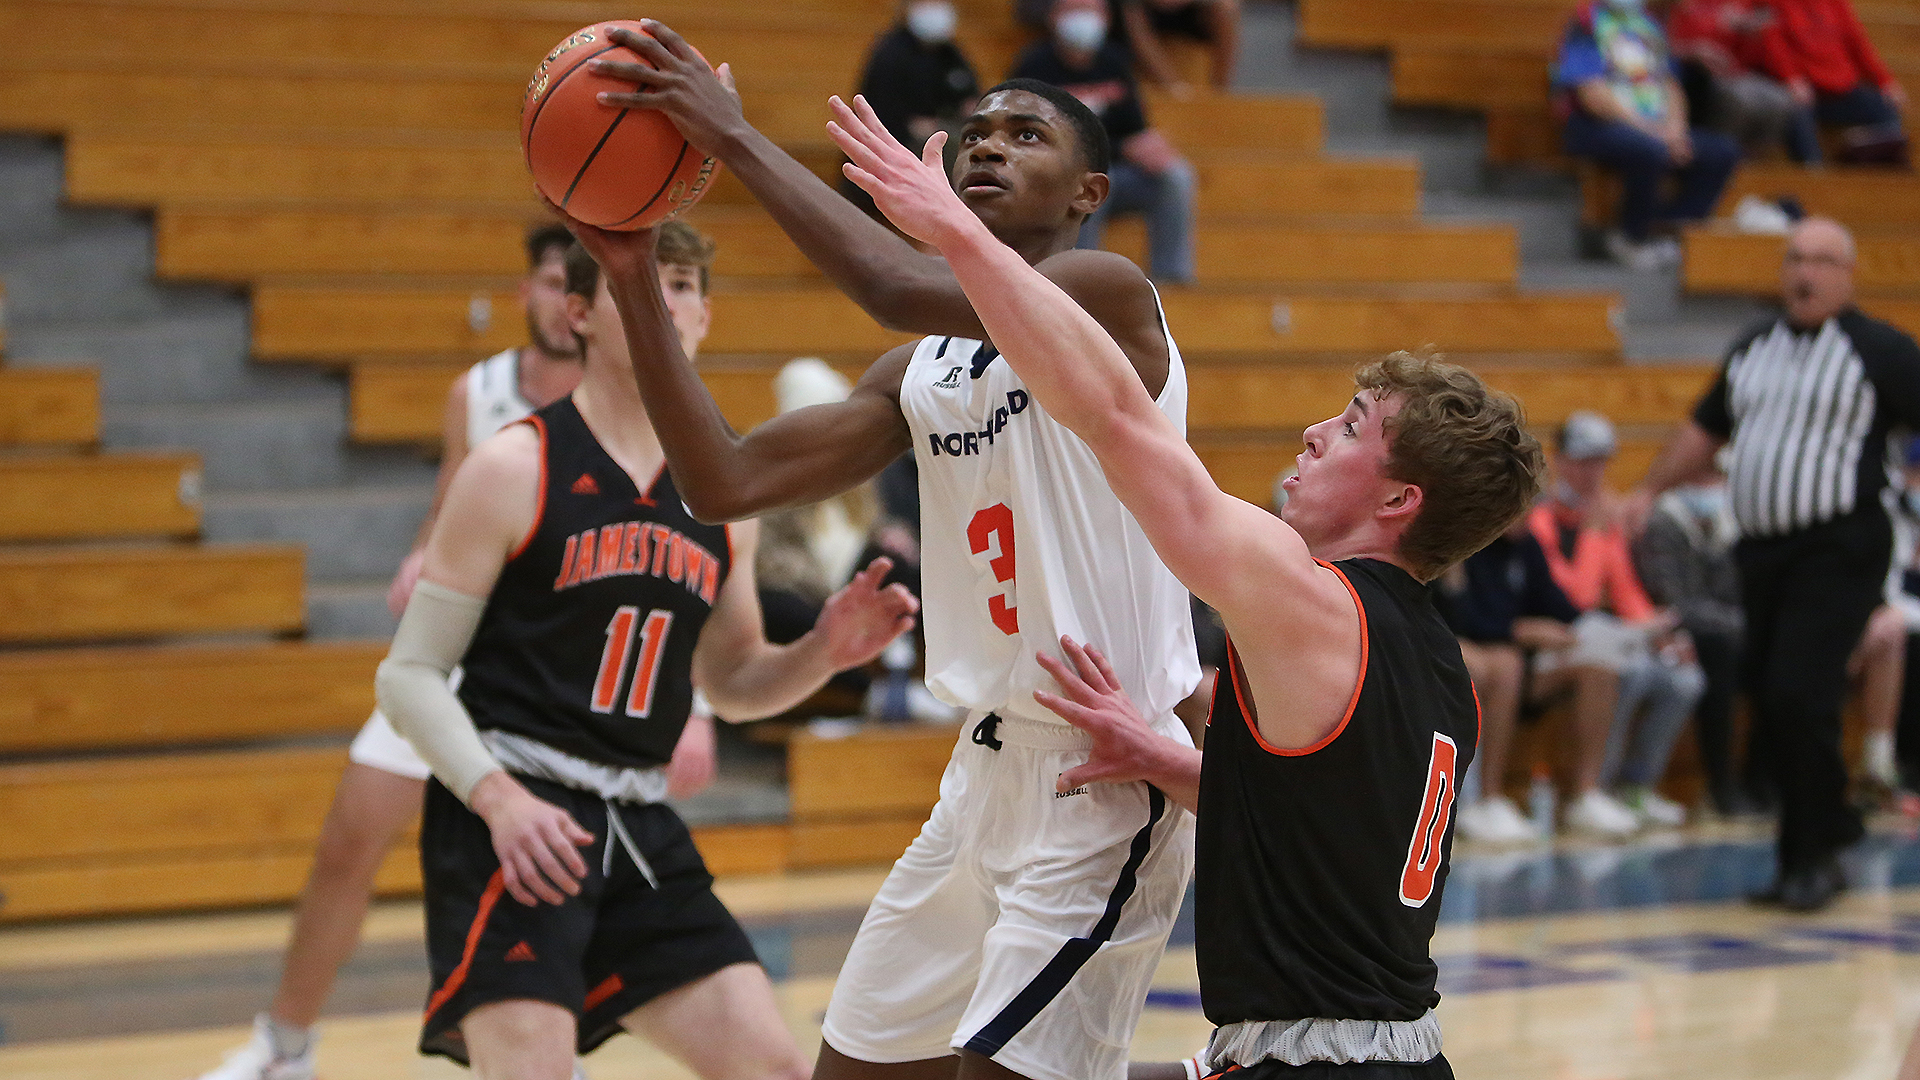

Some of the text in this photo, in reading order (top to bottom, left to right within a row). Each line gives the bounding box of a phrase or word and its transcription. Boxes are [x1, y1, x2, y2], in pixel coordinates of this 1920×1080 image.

[553, 520, 720, 607] JAMESTOWN
[967, 502, 1019, 636] 3
[590, 604, 675, 719] 11
[1398, 730, 1458, 909] 0
